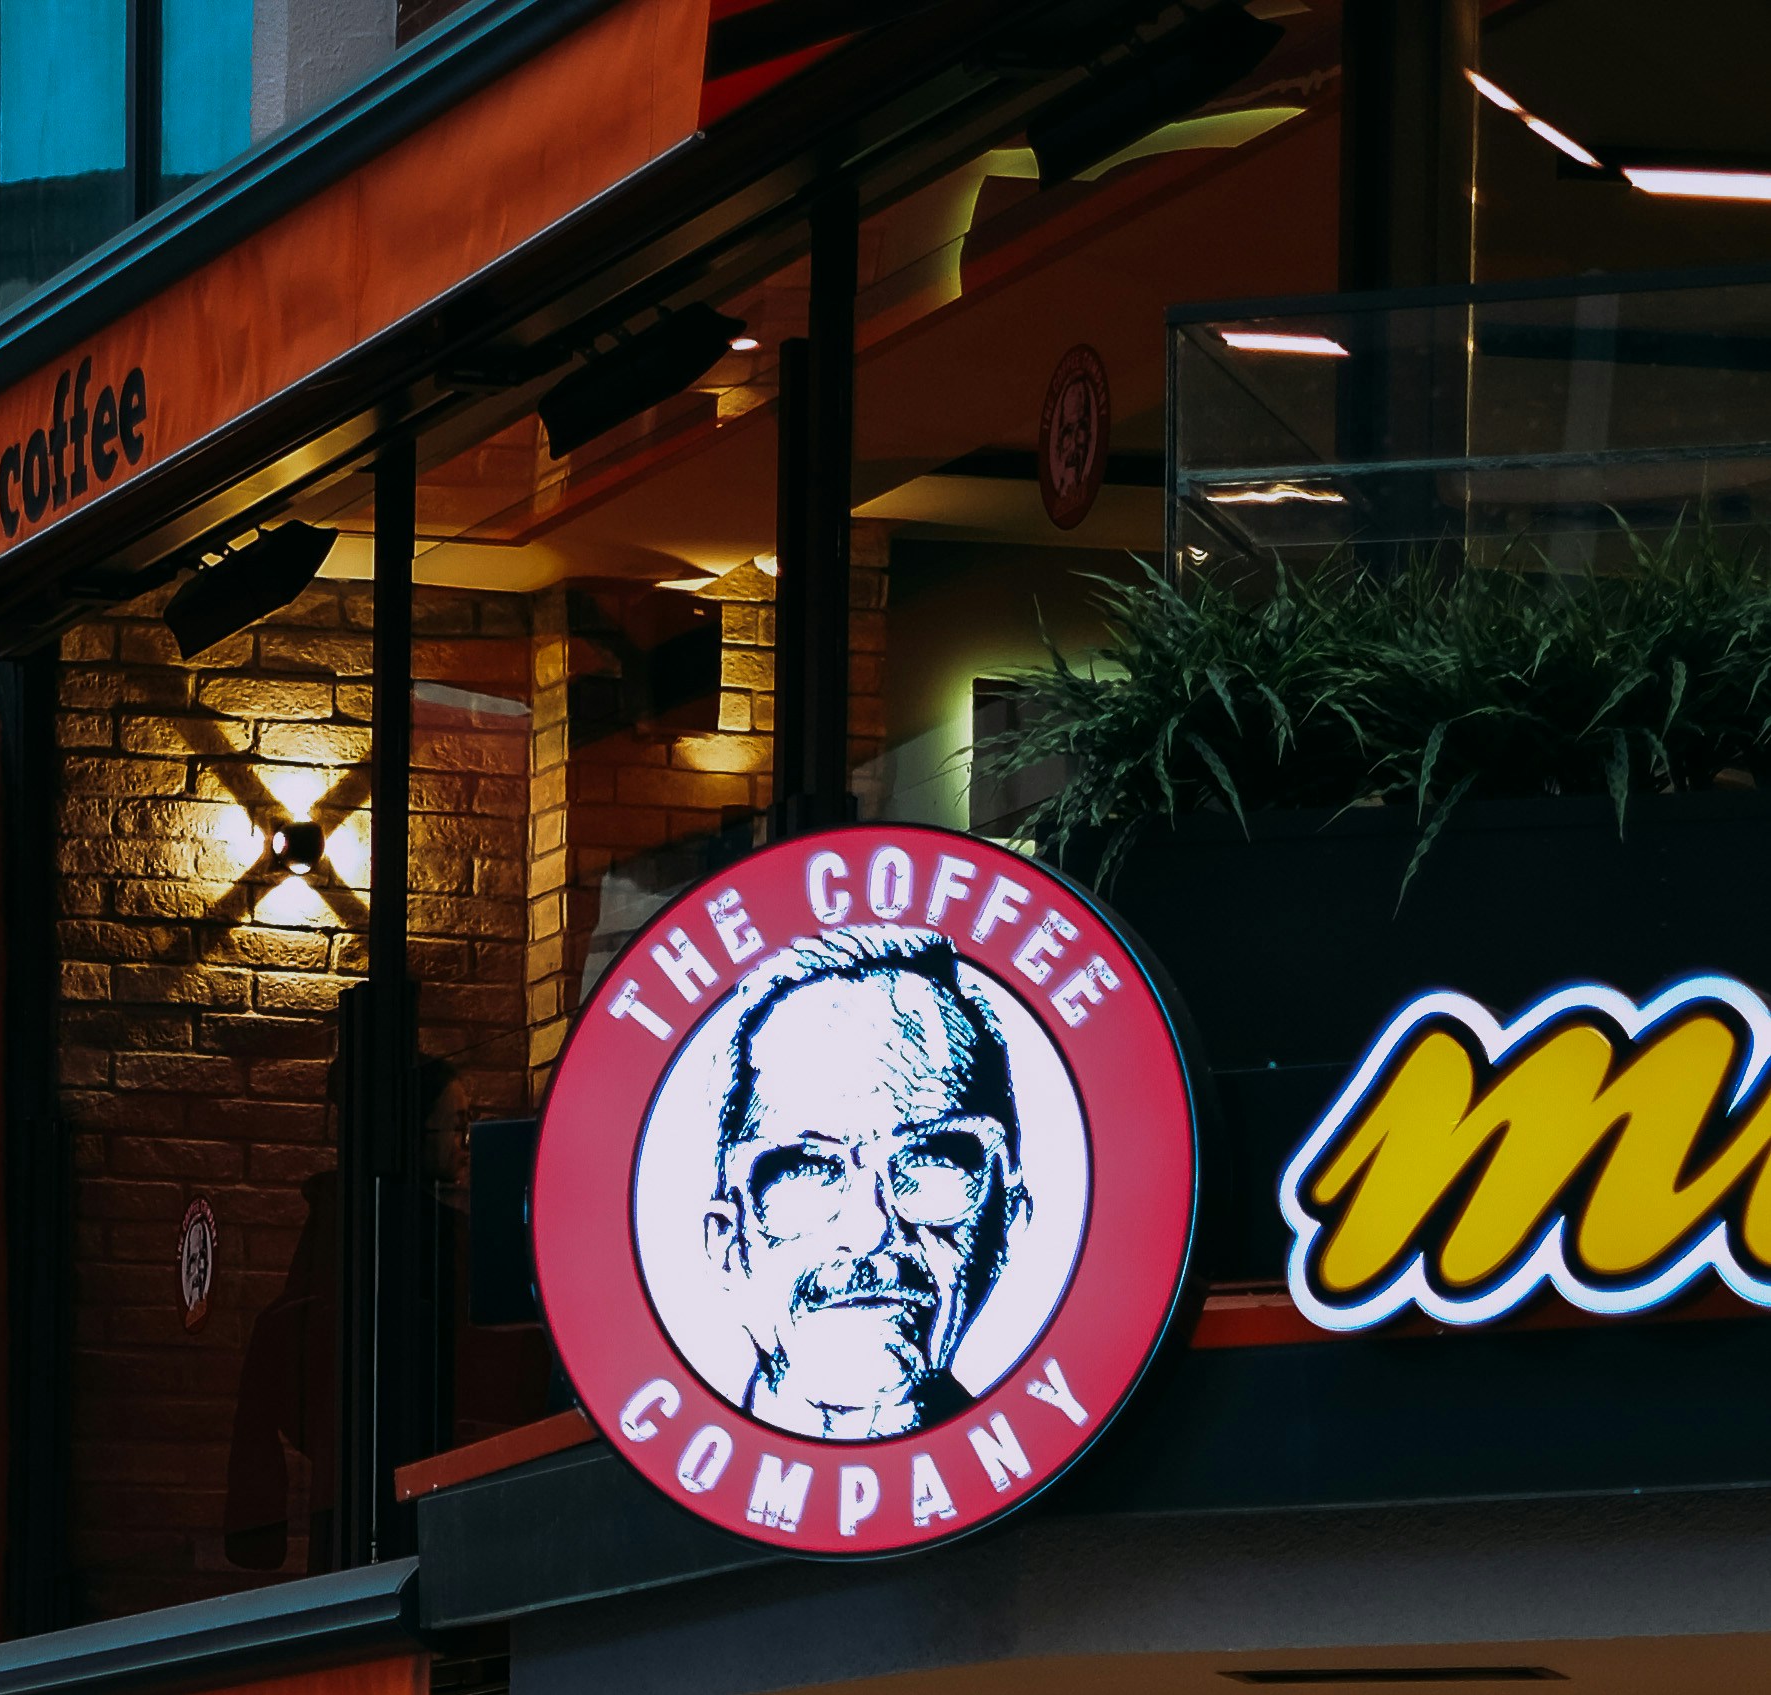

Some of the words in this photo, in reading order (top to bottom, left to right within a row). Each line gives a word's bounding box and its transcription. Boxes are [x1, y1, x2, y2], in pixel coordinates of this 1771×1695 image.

[608, 888, 765, 1041] THE
[806, 846, 1122, 1028] COFFEE
[619, 1358, 1089, 1537] COMPANY
